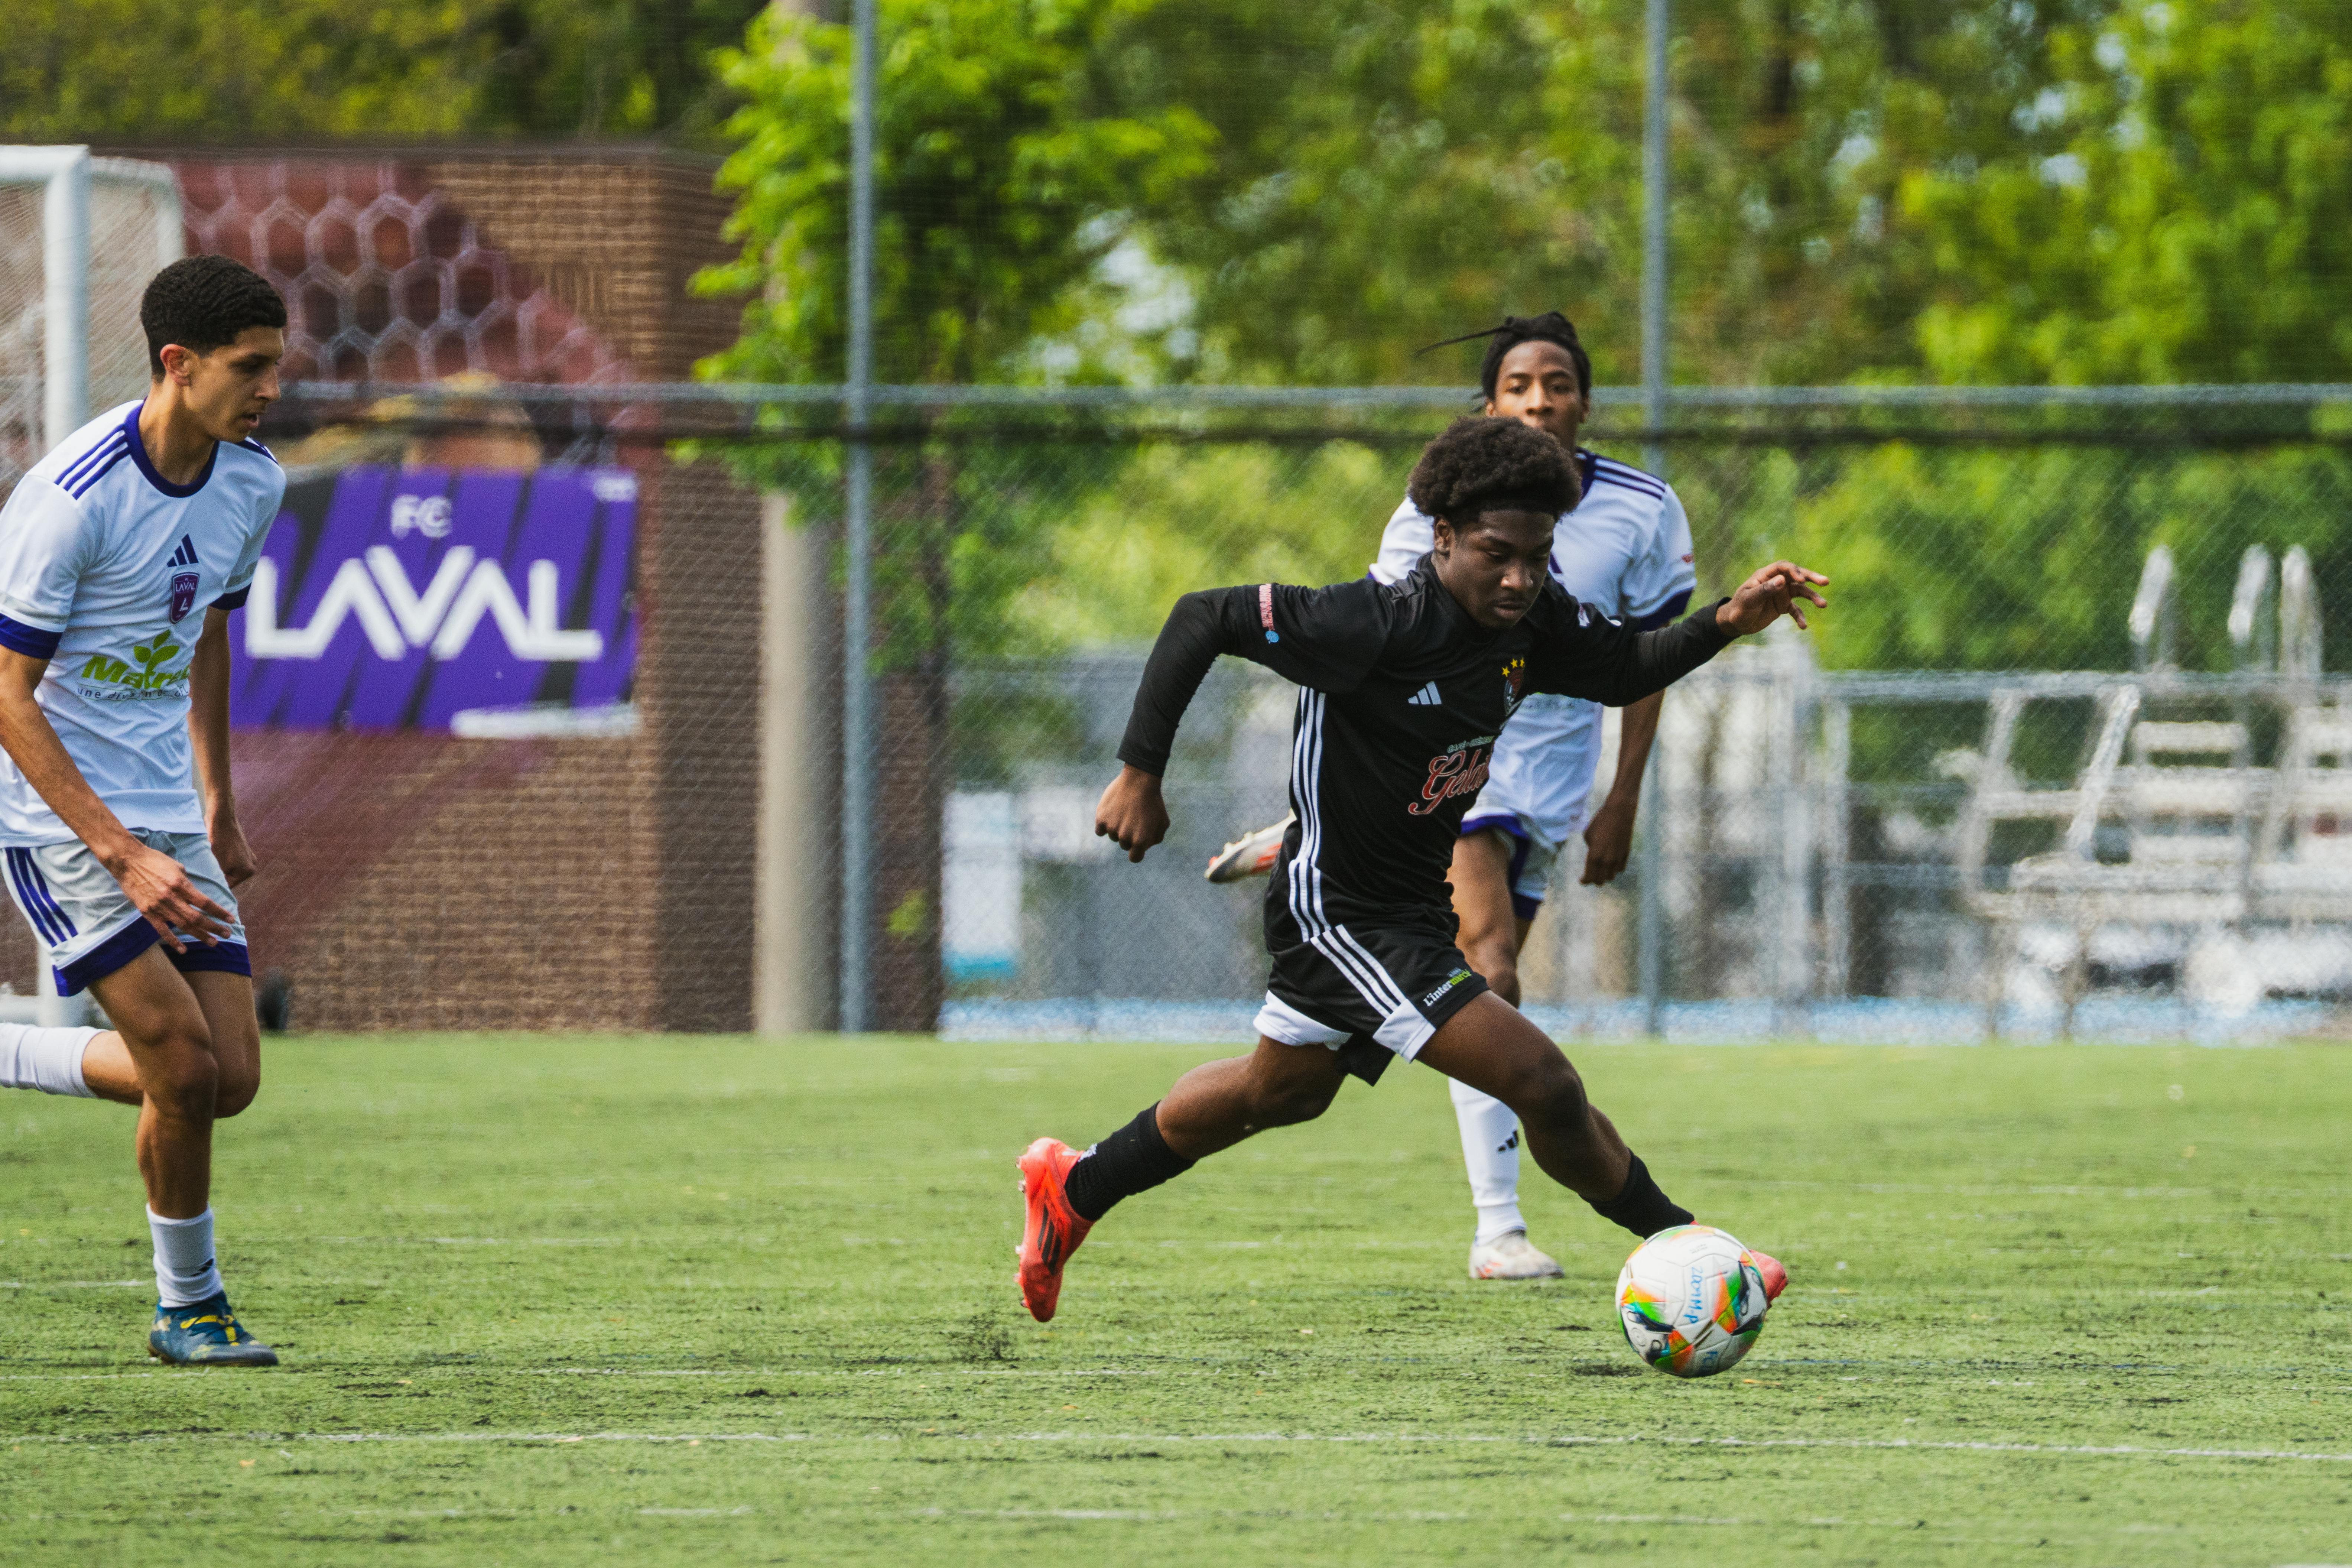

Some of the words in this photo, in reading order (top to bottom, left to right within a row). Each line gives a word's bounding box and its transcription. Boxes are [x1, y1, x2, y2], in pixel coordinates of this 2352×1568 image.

[391, 494, 453, 539] FC
[175, 581, 195, 592] LAVAL
[245, 545, 603, 661] LAVAL
[1408, 749, 1490, 815] Gela
